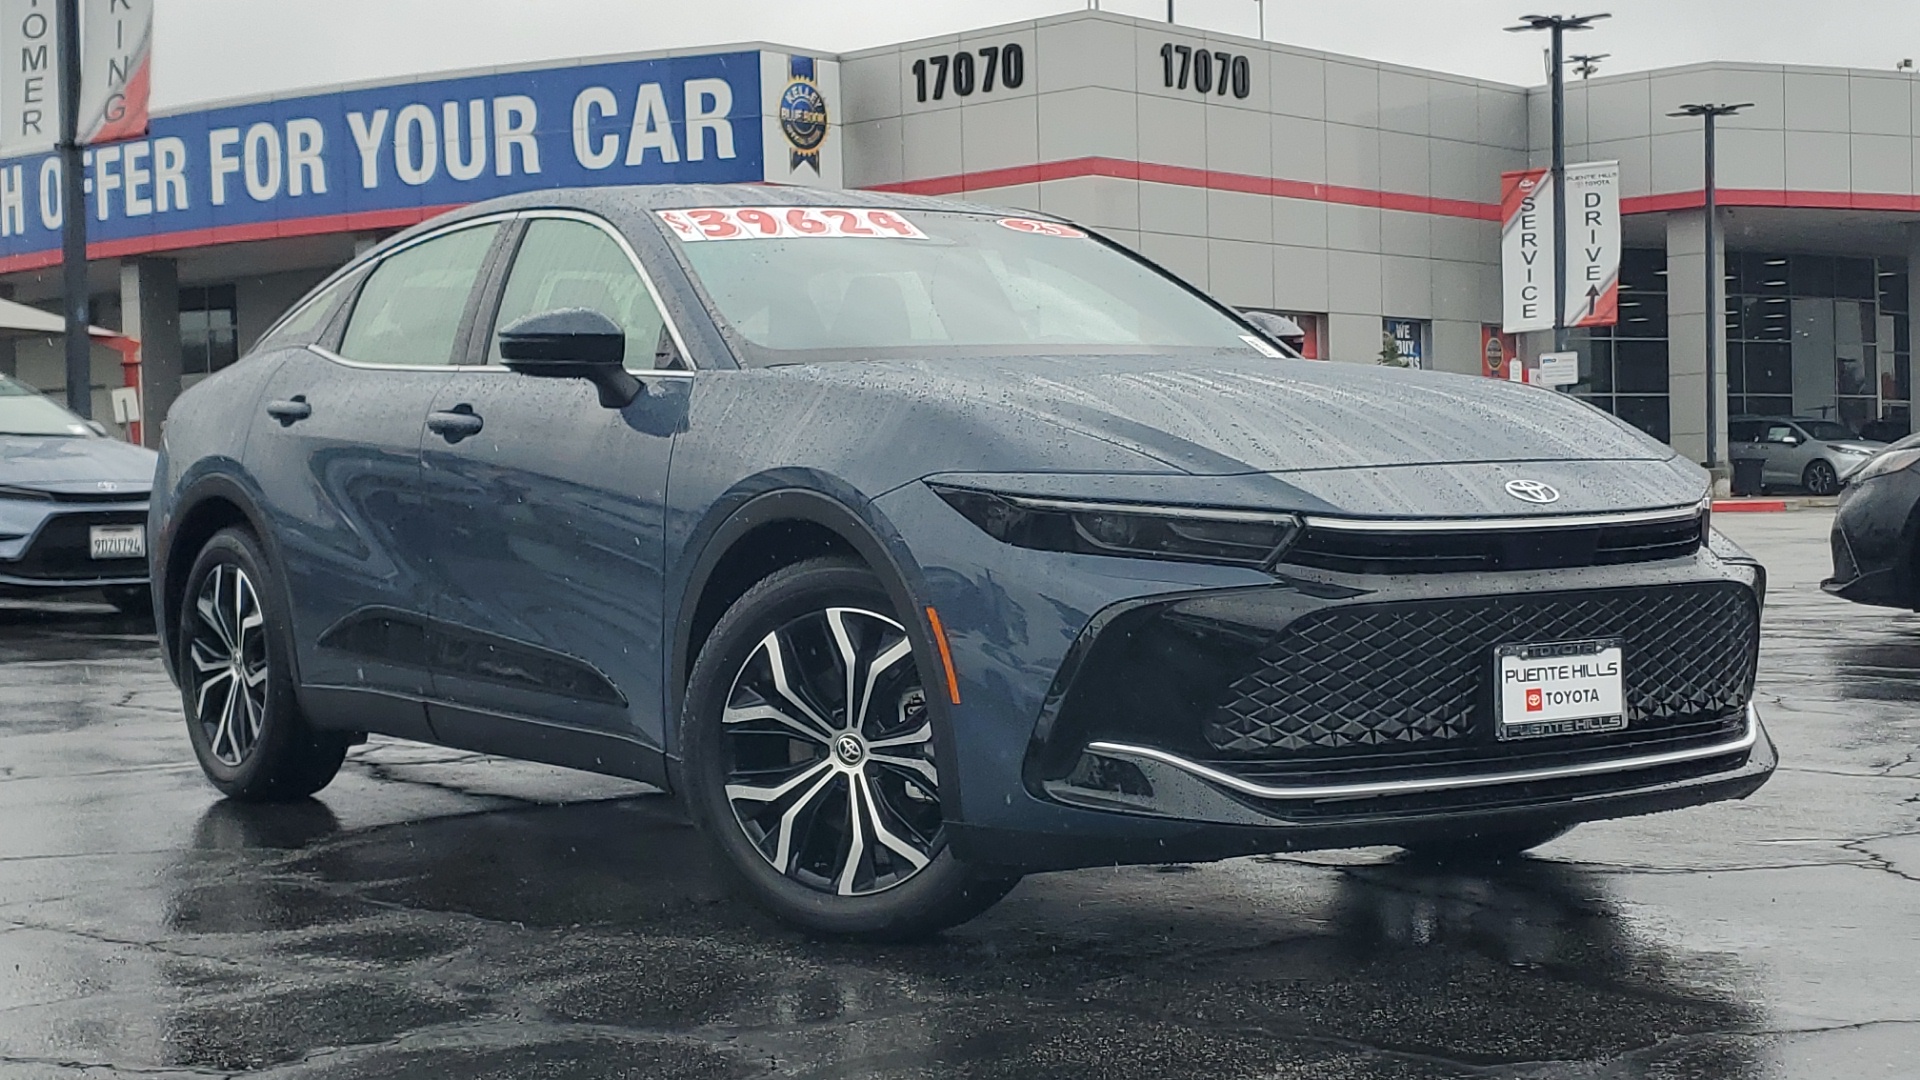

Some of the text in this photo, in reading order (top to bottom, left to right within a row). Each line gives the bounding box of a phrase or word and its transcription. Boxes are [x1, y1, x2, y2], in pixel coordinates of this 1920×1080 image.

[22, 0, 48, 136] OMER
[912, 43, 1024, 102] 17070
[1160, 42, 1250, 99] 17070
[785, 85, 822, 108] KELLEY
[209, 118, 326, 205] FOR
[347, 95, 541, 189] YOUR
[572, 77, 737, 170] CAR
[1585, 192, 1602, 281] DRIVE
[1521, 196, 1538, 319] SERVICE
[1395, 323, 1411, 339] WE
[1529, 643, 1594, 656] TOYOTA
[1505, 662, 1617, 684] PUENTE HILLS
[1545, 688, 1599, 705] TOYOTA
[1508, 716, 1621, 736] PUENTE HILLS
